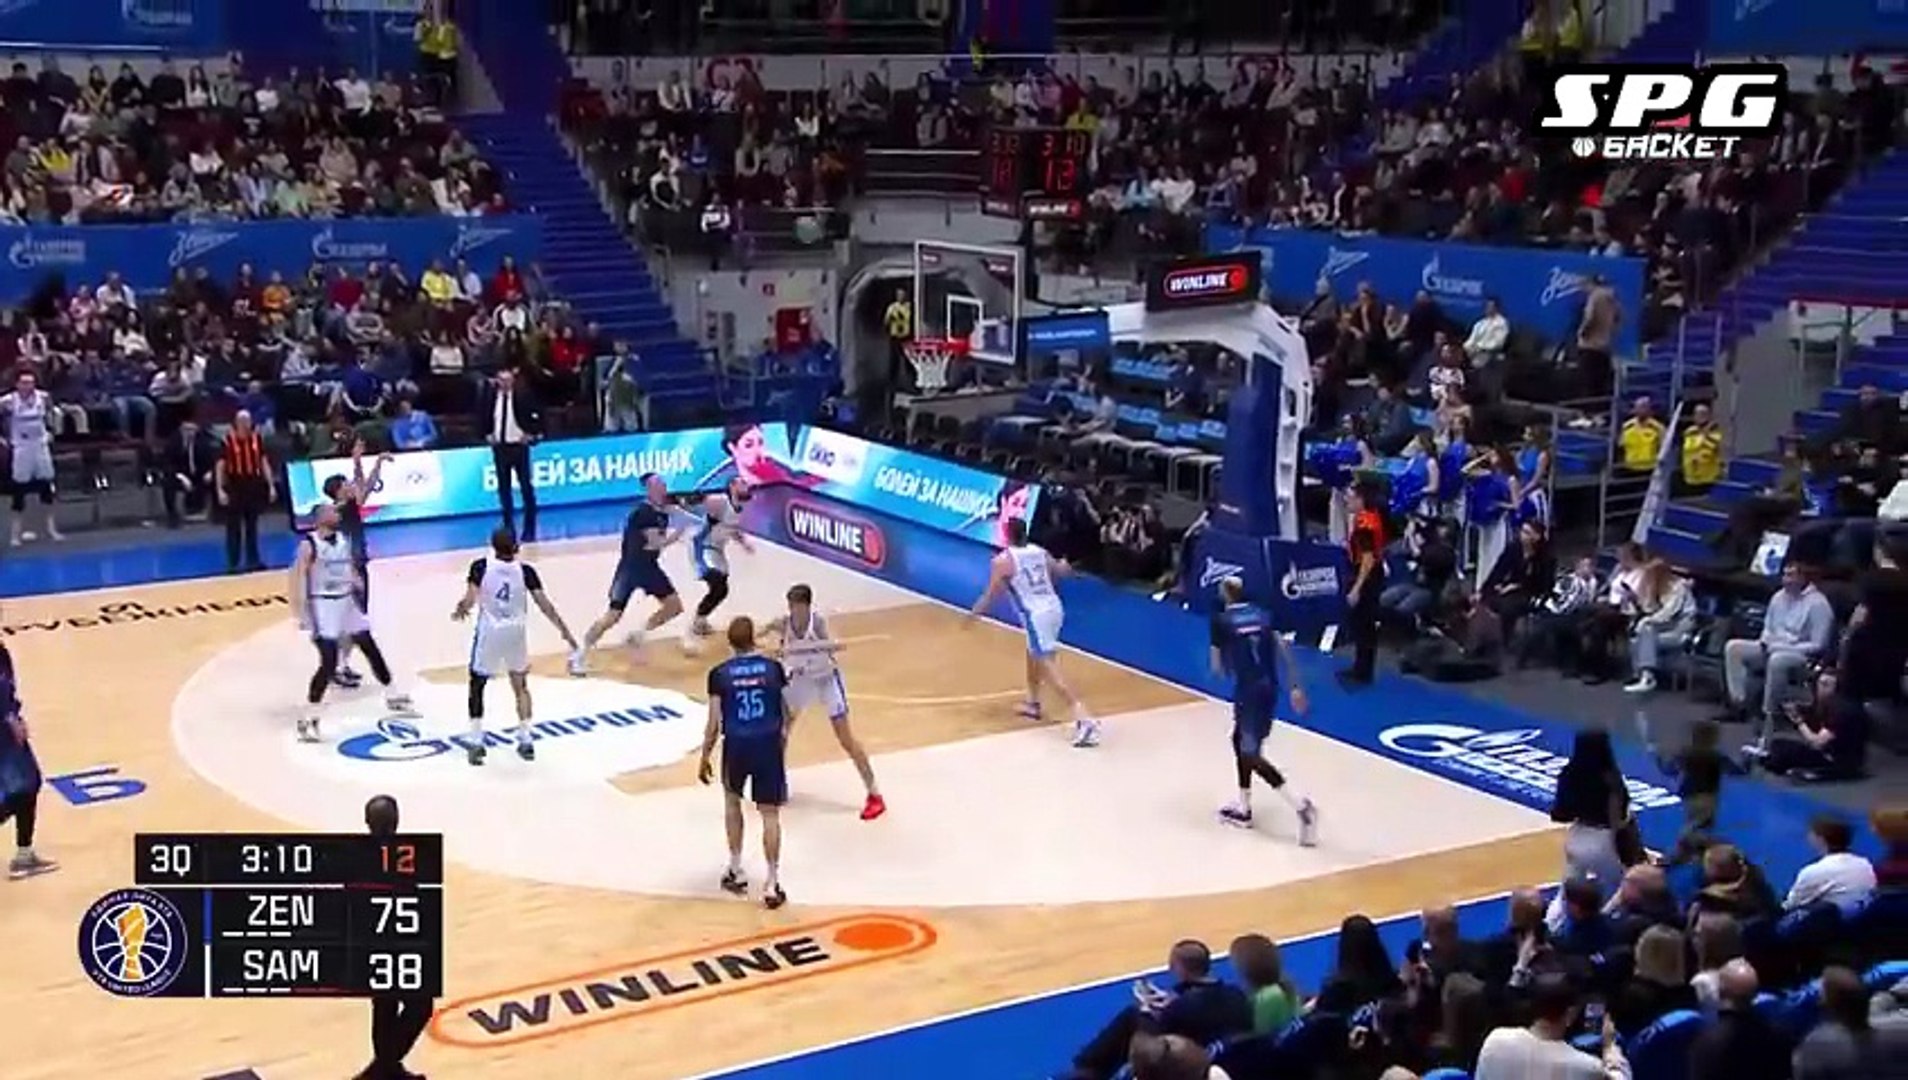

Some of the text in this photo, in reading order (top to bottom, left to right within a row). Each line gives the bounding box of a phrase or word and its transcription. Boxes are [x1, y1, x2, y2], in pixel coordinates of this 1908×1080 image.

[1168, 271, 1229, 292] WINLINE
[483, 445, 694, 492] БЕЙ ЗА НАШИХ
[917, 476, 940, 504] ЗА
[792, 509, 863, 554] WINLINE
[495, 582, 511, 603] 4
[736, 688, 766, 721] 35
[468, 936, 830, 1035] WINLINE
